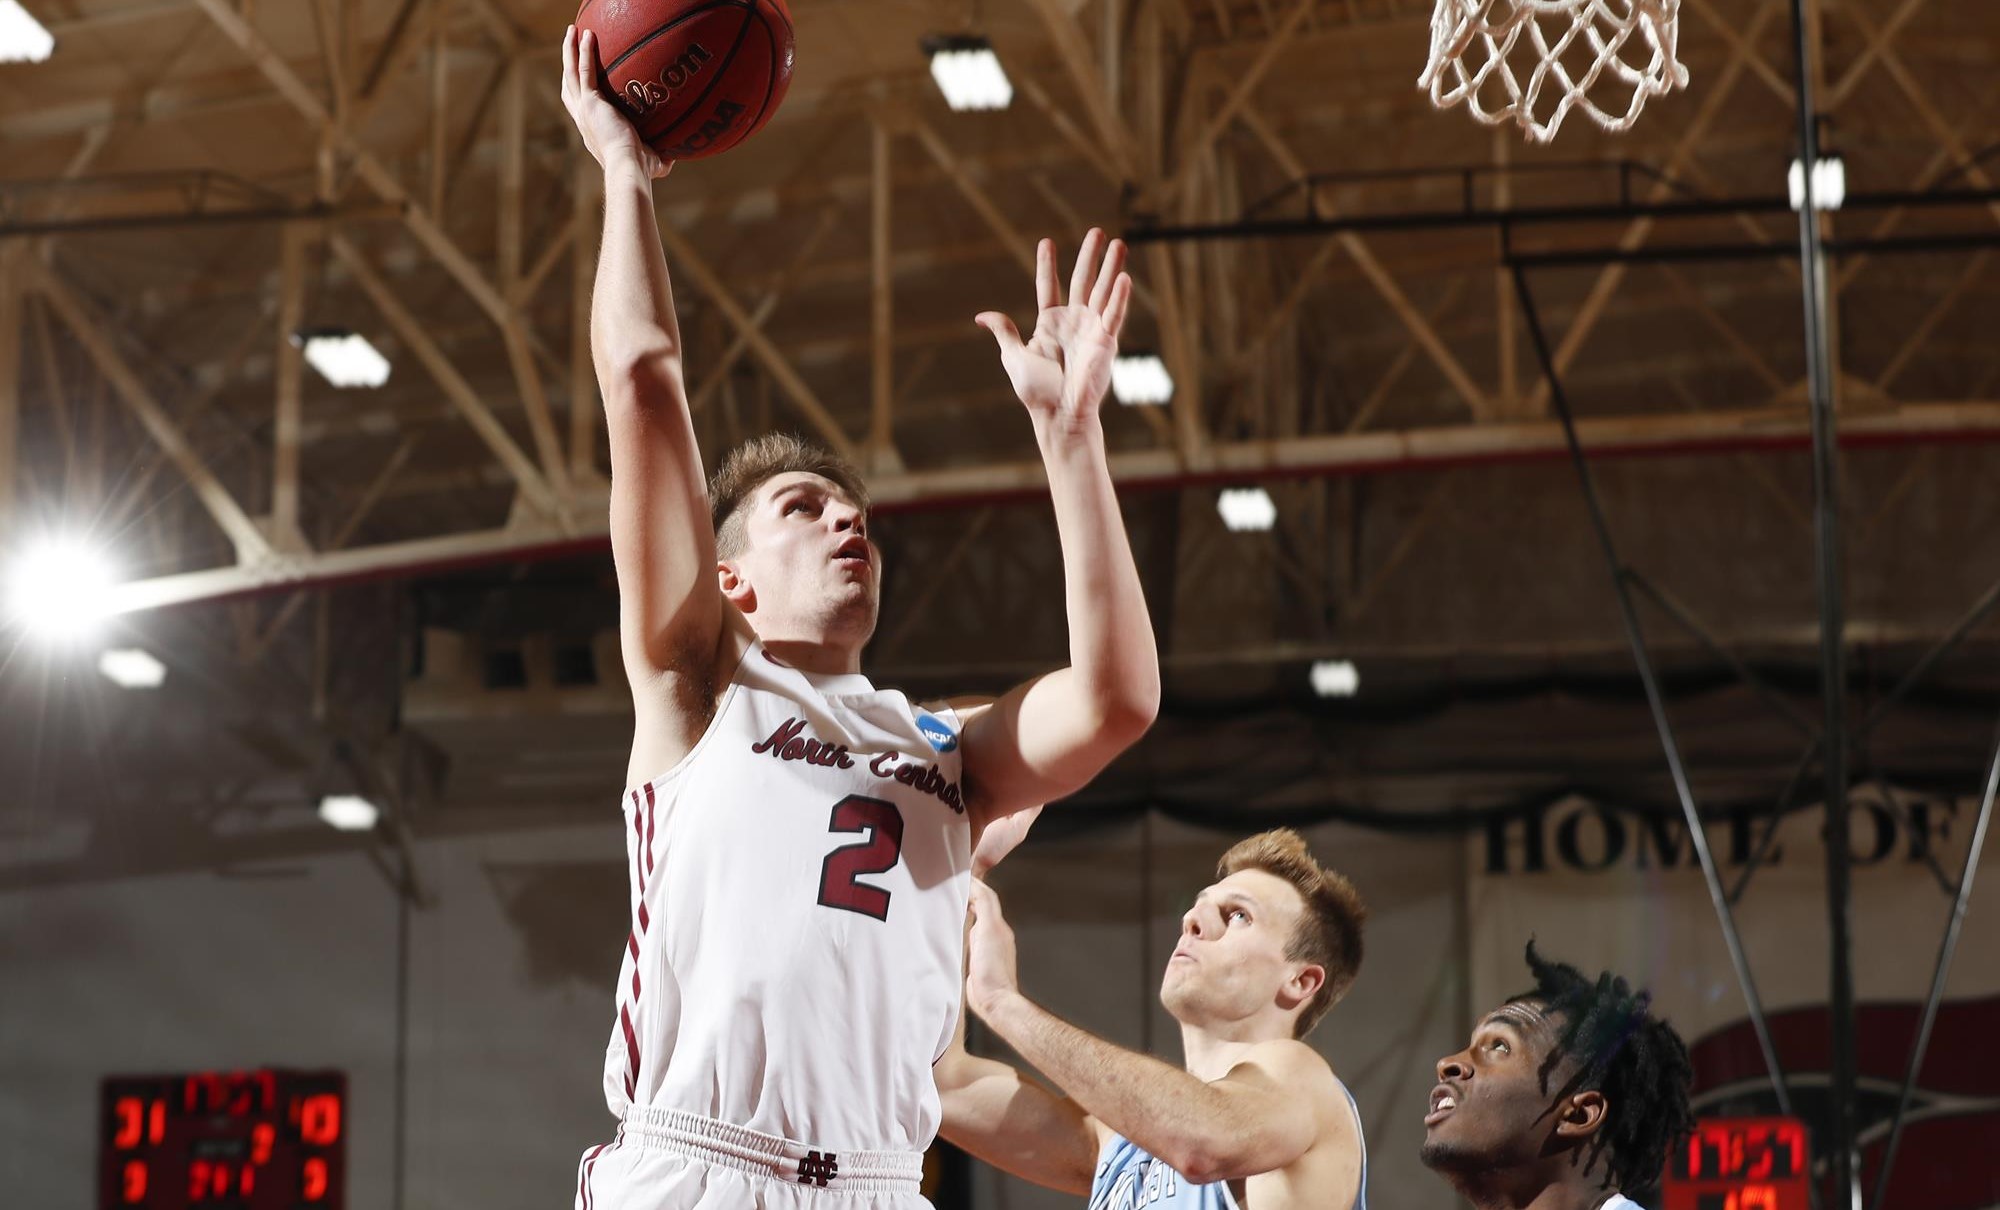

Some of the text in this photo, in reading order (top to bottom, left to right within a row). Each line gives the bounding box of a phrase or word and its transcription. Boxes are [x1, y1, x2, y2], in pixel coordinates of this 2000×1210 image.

[618, 42, 714, 114] ilson
[751, 716, 854, 769] North
[816, 793, 904, 922] 2
[1485, 803, 1783, 876] HOME
